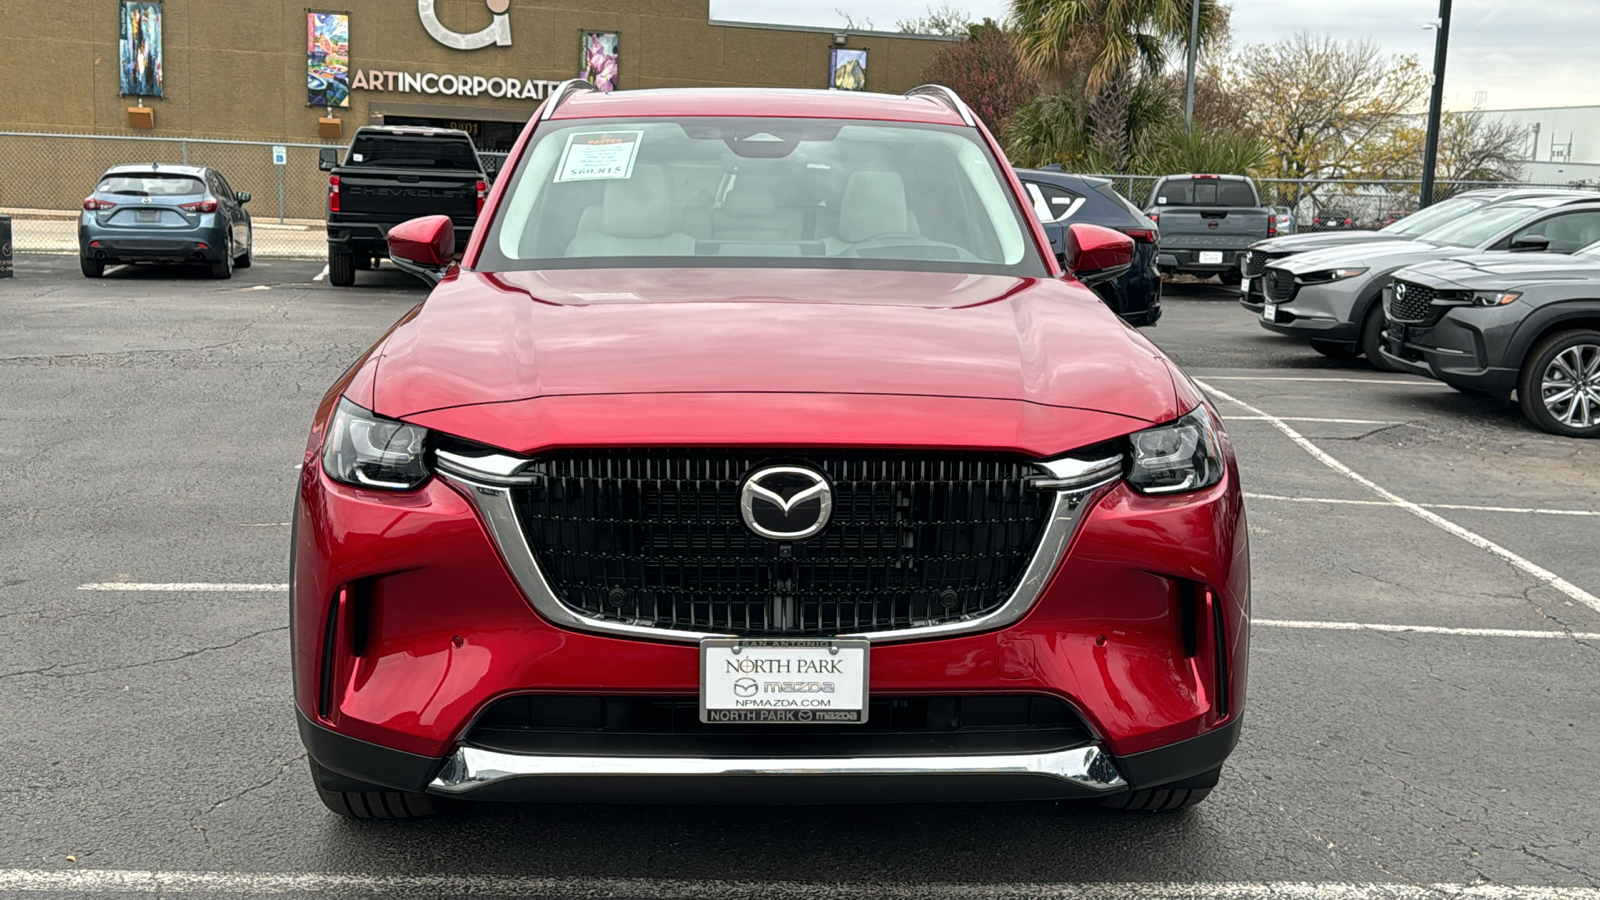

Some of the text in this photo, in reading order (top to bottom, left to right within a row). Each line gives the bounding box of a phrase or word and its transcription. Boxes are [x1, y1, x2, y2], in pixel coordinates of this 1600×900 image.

[350, 187, 467, 198] CHEVROLET
[725, 658, 843, 674] NORTH PARK
[735, 699, 831, 707] NPMAZDA.COM
[710, 711, 754, 721] NORTH
[760, 711, 795, 721] PARK
